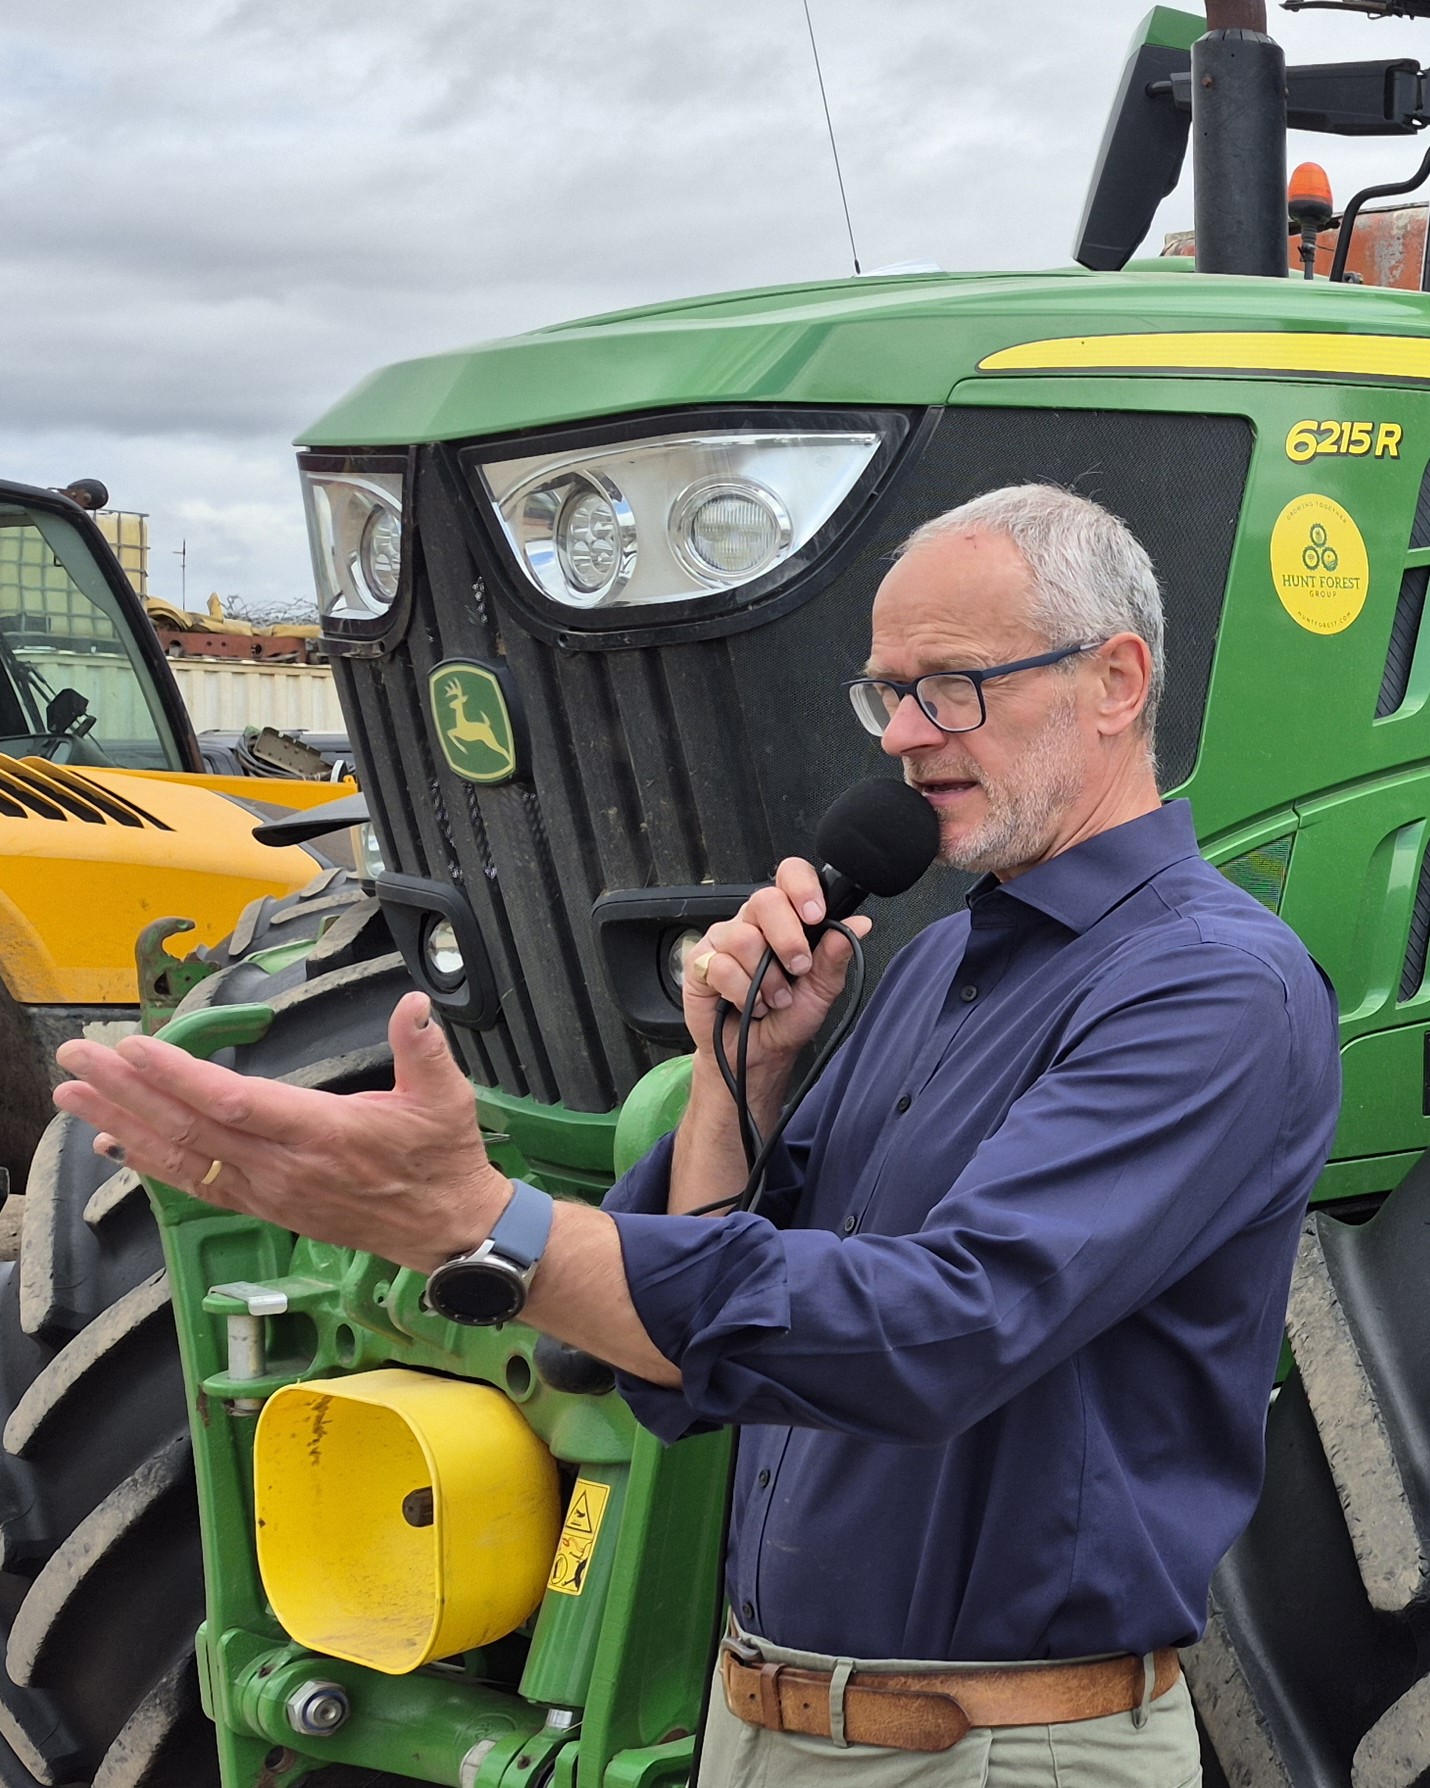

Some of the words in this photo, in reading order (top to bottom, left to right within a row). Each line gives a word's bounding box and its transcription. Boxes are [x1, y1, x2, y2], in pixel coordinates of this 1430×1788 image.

[1285, 420, 1402, 464] 6215R
[1282, 574, 1316, 588] HUNT
[1319, 576, 1360, 590] FOREST
[1309, 590, 1337, 598] GROUP
